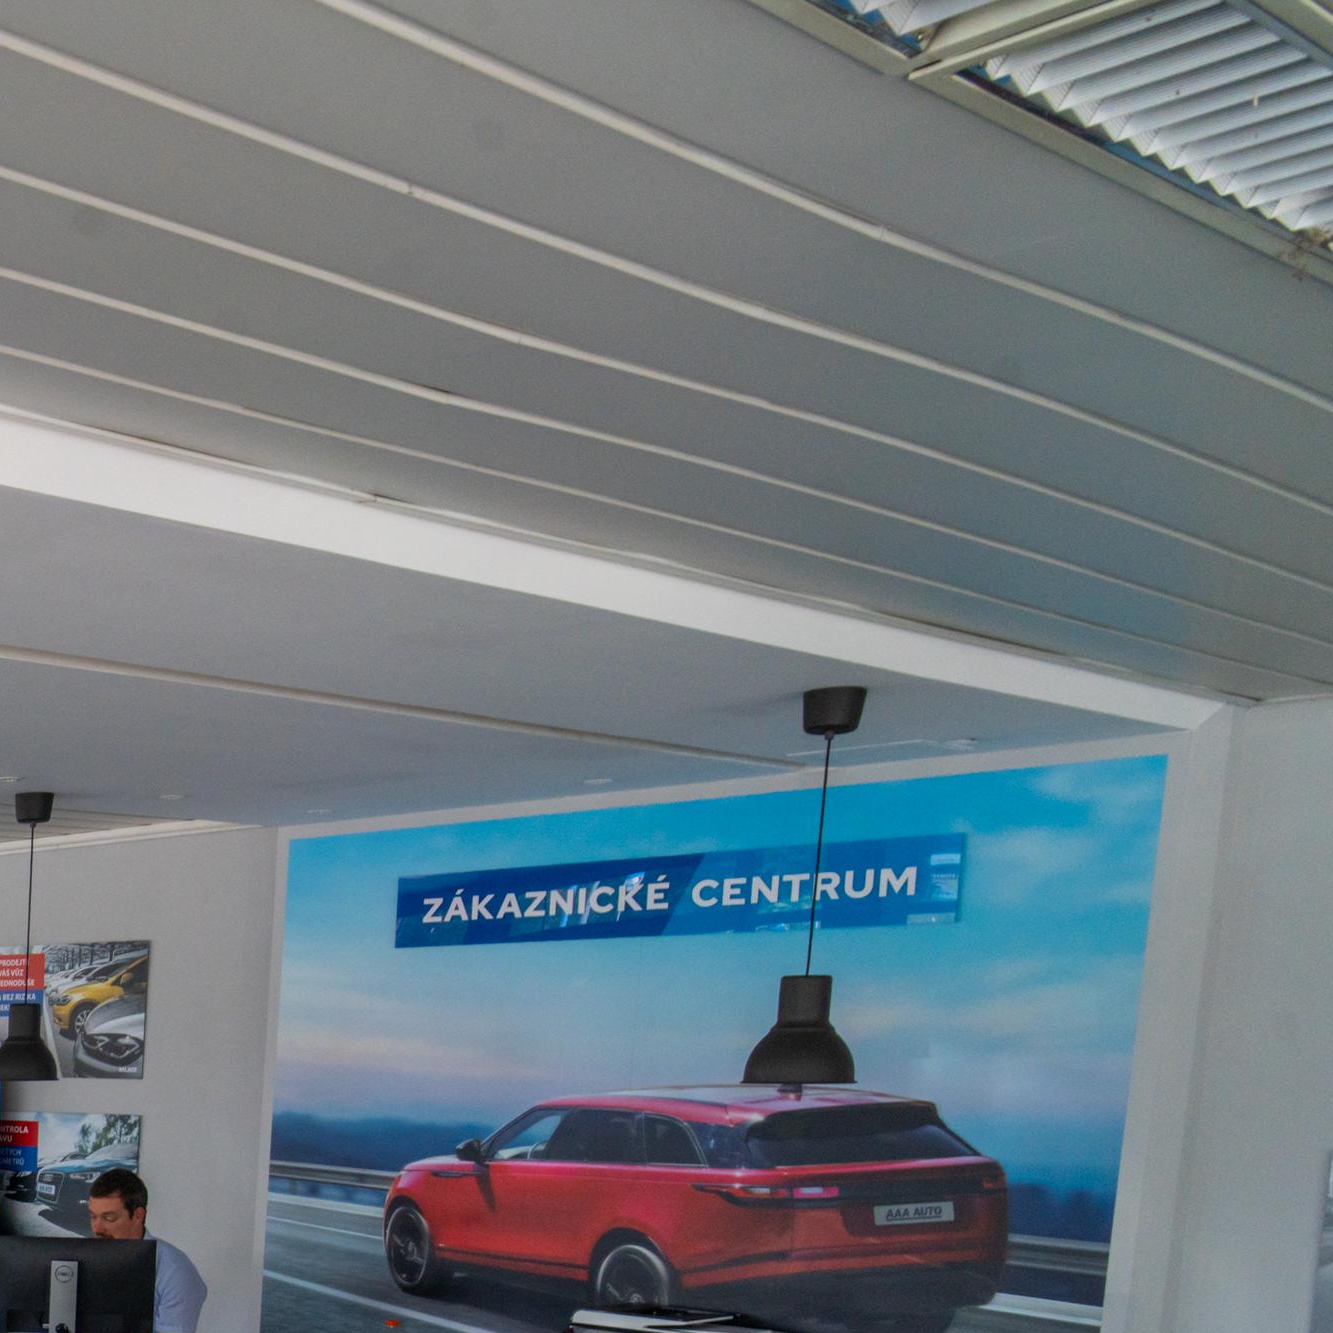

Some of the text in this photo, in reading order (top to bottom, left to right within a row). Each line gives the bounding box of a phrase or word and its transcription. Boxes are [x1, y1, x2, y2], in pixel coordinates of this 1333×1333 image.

[422, 866, 918, 924] ZÁKAZNICKÉ CENTRUM
[15, 993, 36, 1001] RIZKA
